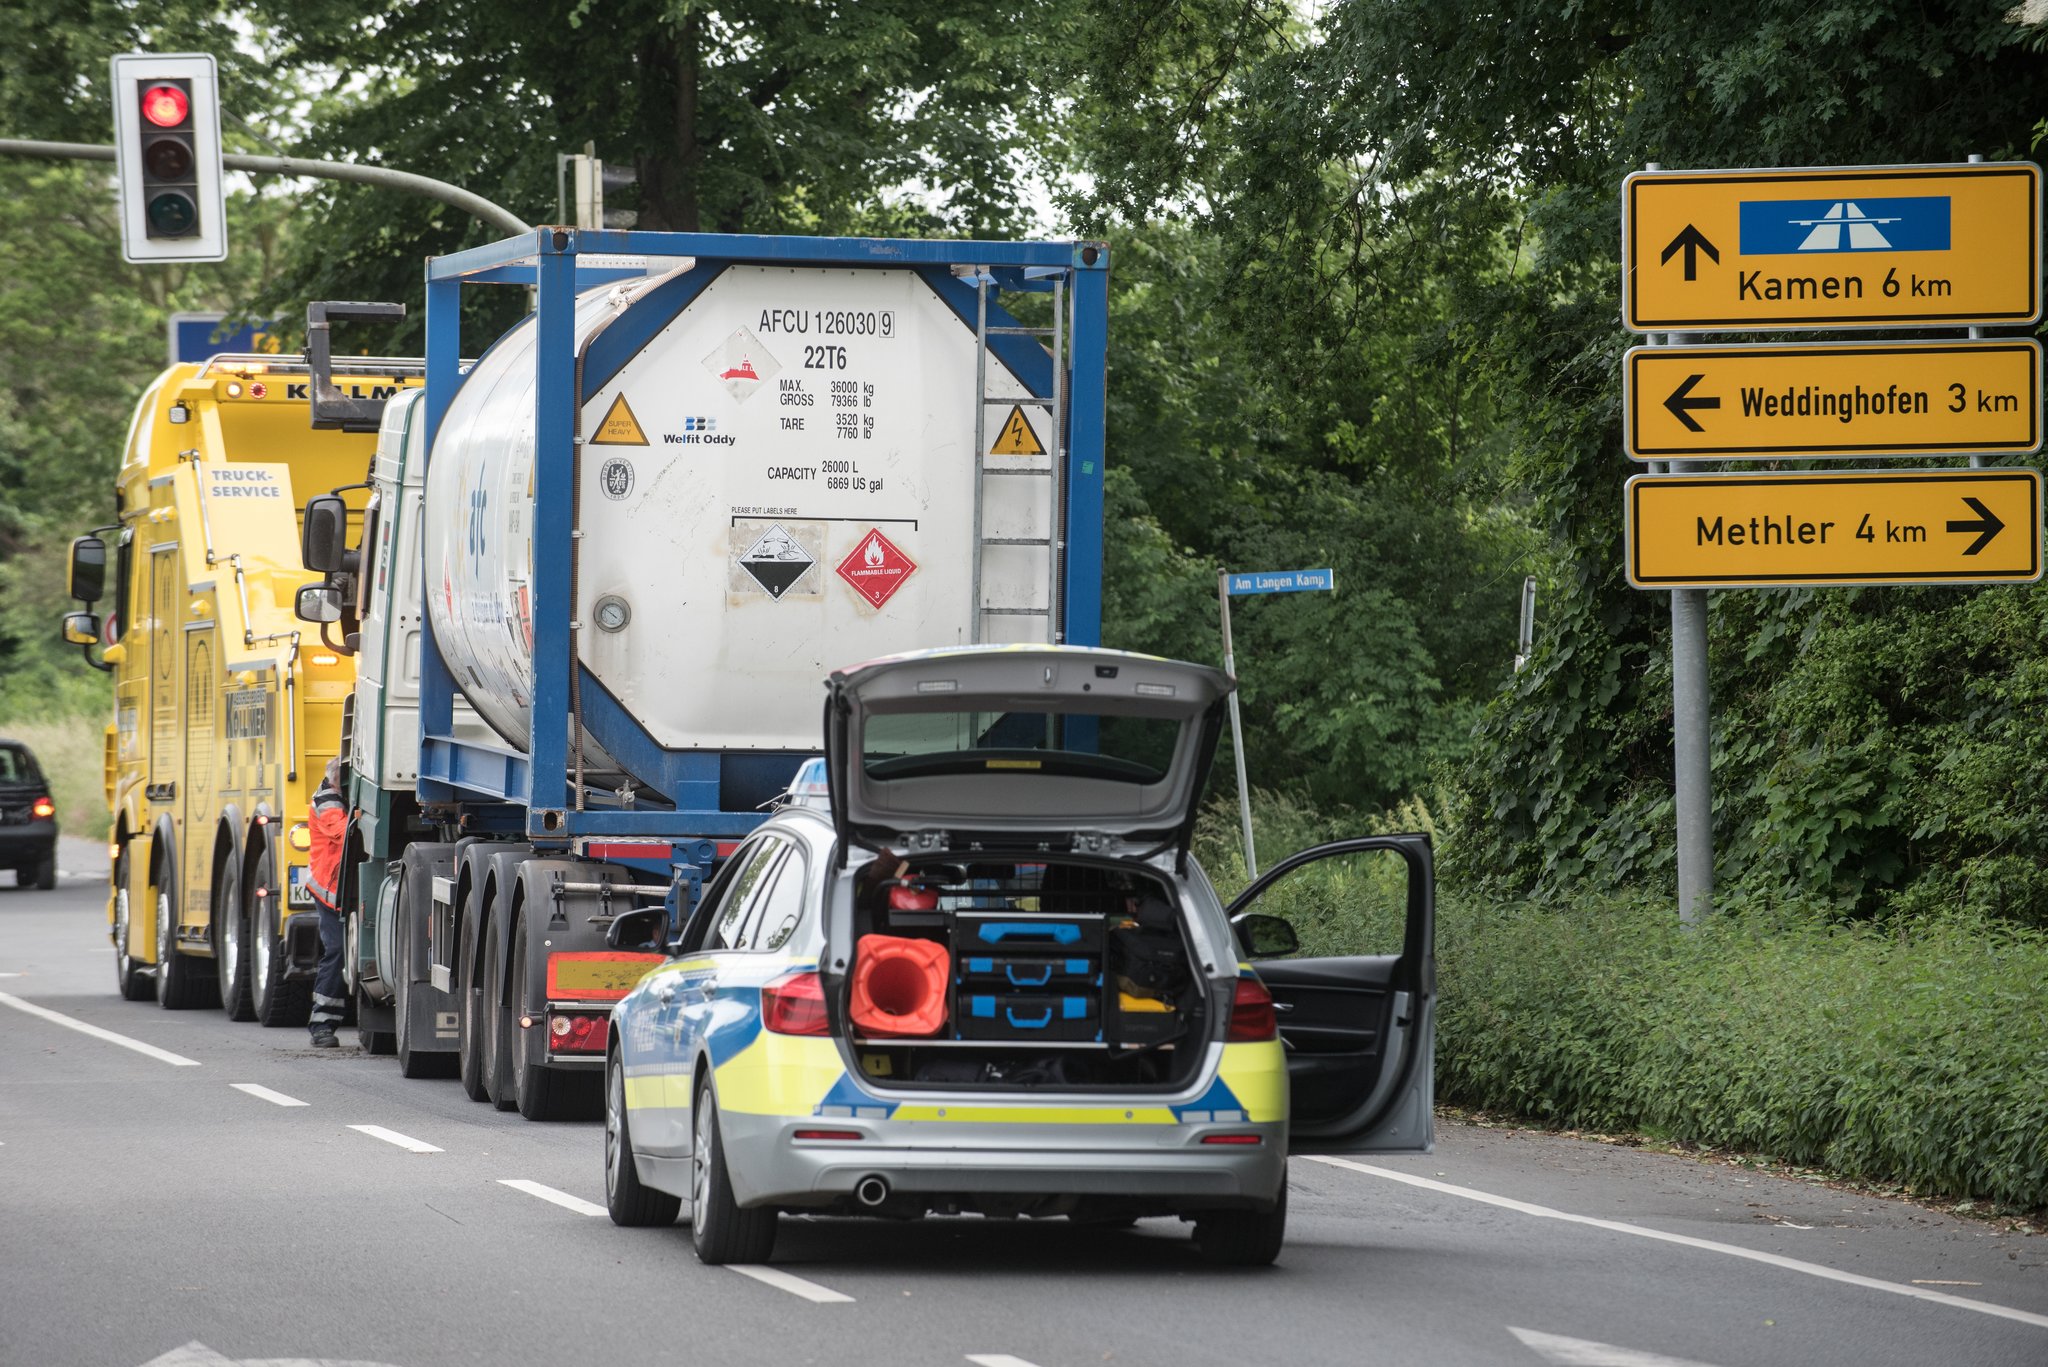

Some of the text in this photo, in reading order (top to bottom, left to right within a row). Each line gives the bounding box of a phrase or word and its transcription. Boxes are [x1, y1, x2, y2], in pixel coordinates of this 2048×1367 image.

[1739, 268, 1952, 301] Kamen 6 km
[759, 310, 891, 336] AFCU 126030 9
[804, 345, 847, 370] 22T6
[780, 379, 804, 392] MAX.
[831, 381, 874, 397] 36000 kg
[780, 393, 814, 406] GROSS
[831, 395, 872, 407] 79366 lb
[1741, 383, 2018, 423] Weddinghofen 3 km
[780, 418, 804, 430] TARE
[836, 413, 874, 429] 3520 kg
[837, 427, 872, 439] 7760 lb
[663, 434, 736, 446] Welfit Oddy
[822, 460, 859, 473] 26000 L
[212, 470, 274, 481] TRUCK-
[767, 467, 817, 480] CAPACITY
[212, 486, 280, 497] SERVICE
[827, 477, 883, 493] 6869 US gal
[732, 506, 751, 514] PLEASE
[1697, 514, 1927, 546] Methler 4 km
[851, 569, 883, 577] FLAMMABLE
[774, 585, 779, 593] 8
[1235, 574, 1324, 591] Am Langen Kamp
